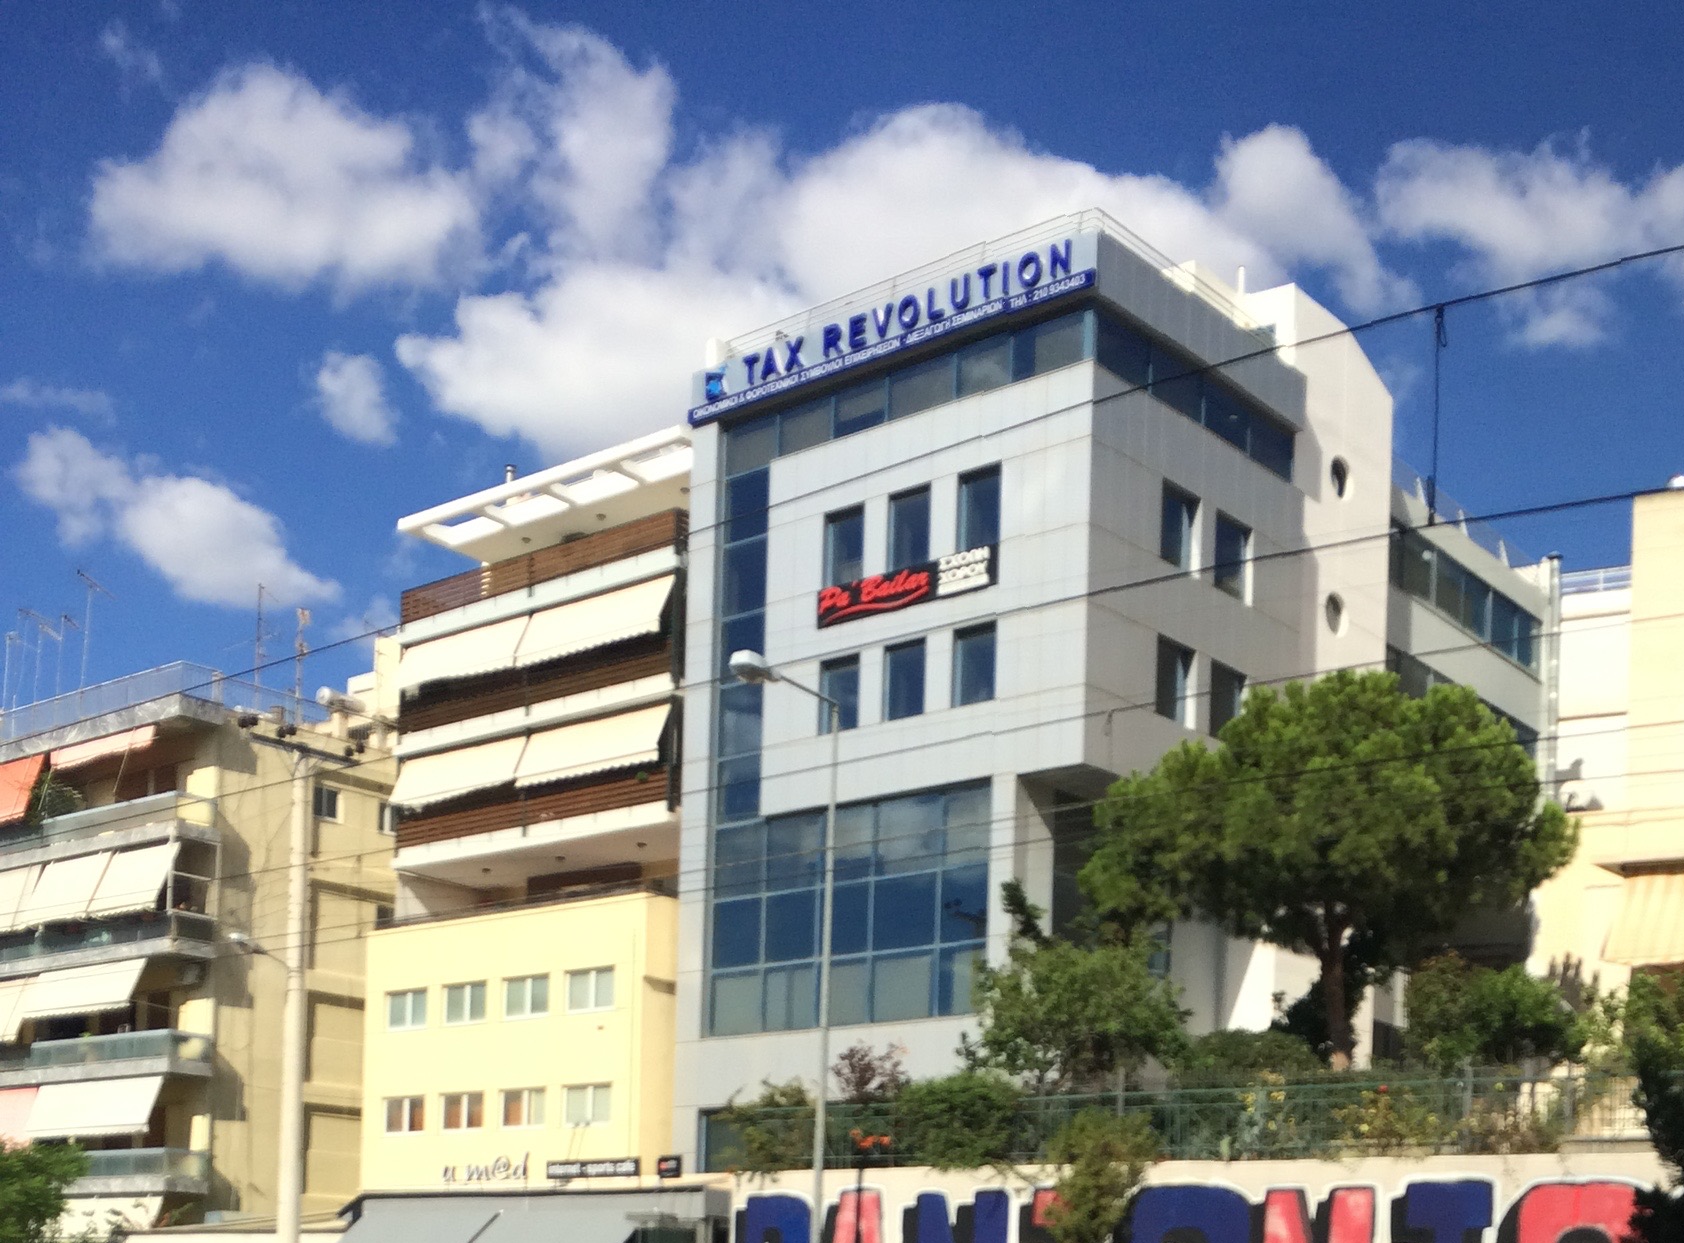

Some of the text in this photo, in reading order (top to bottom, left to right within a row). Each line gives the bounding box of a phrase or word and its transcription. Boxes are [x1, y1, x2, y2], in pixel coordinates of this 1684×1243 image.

[742, 238, 1073, 386] TAX REVOLUTION
[1033, 288, 1049, 301] 210
